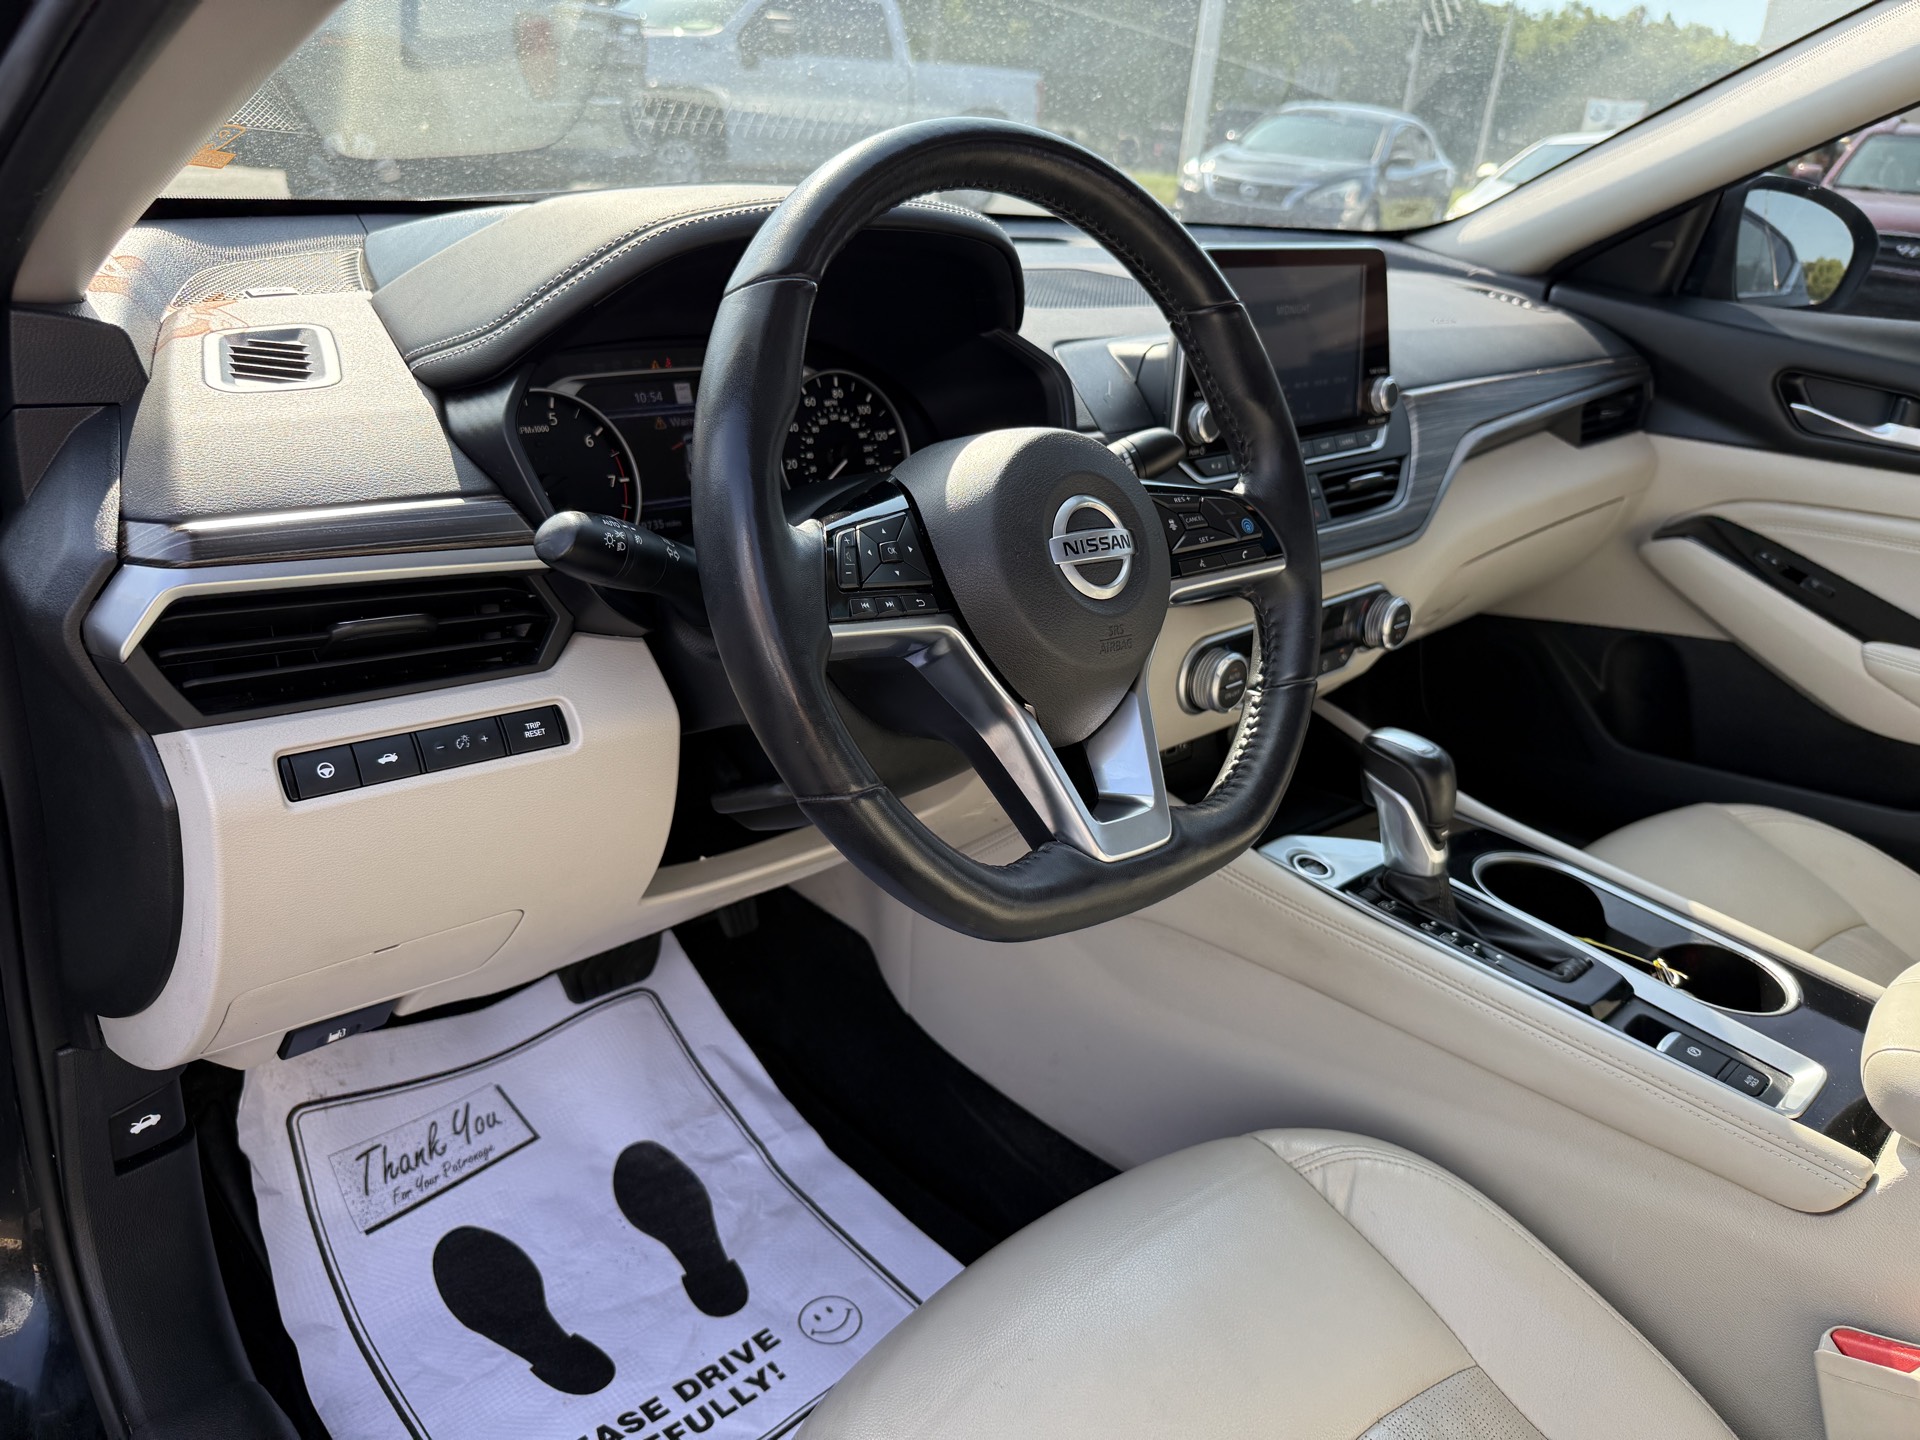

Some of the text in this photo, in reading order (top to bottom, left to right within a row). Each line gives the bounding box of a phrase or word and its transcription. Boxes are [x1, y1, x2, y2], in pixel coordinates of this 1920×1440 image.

[634, 391, 664, 404] 10:54
[831, 387, 844, 399] 80
[804, 396, 817, 407] 60
[857, 404, 872, 415] 100
[548, 412, 559, 426] 5
[584, 434, 596, 448] 6
[874, 430, 888, 441] 120
[786, 457, 798, 470] 20
[607, 475, 616, 488] 7
[1185, 515, 1204, 524] CANCEL
[887, 547, 898, 555] OK
[1062, 533, 1132, 557] NISSAN
[1108, 624, 1125, 637] SRS
[1099, 638, 1133, 654] AIRBAG
[524, 721, 541, 730] TRIP
[524, 728, 546, 739] RESET
[355, 1101, 504, 1197] Thank You
[392, 1144, 496, 1205] For Your Patronage
[577, 1327, 782, 1440] ASE DRIVE
[643, 1361, 787, 1440] FULLY!
